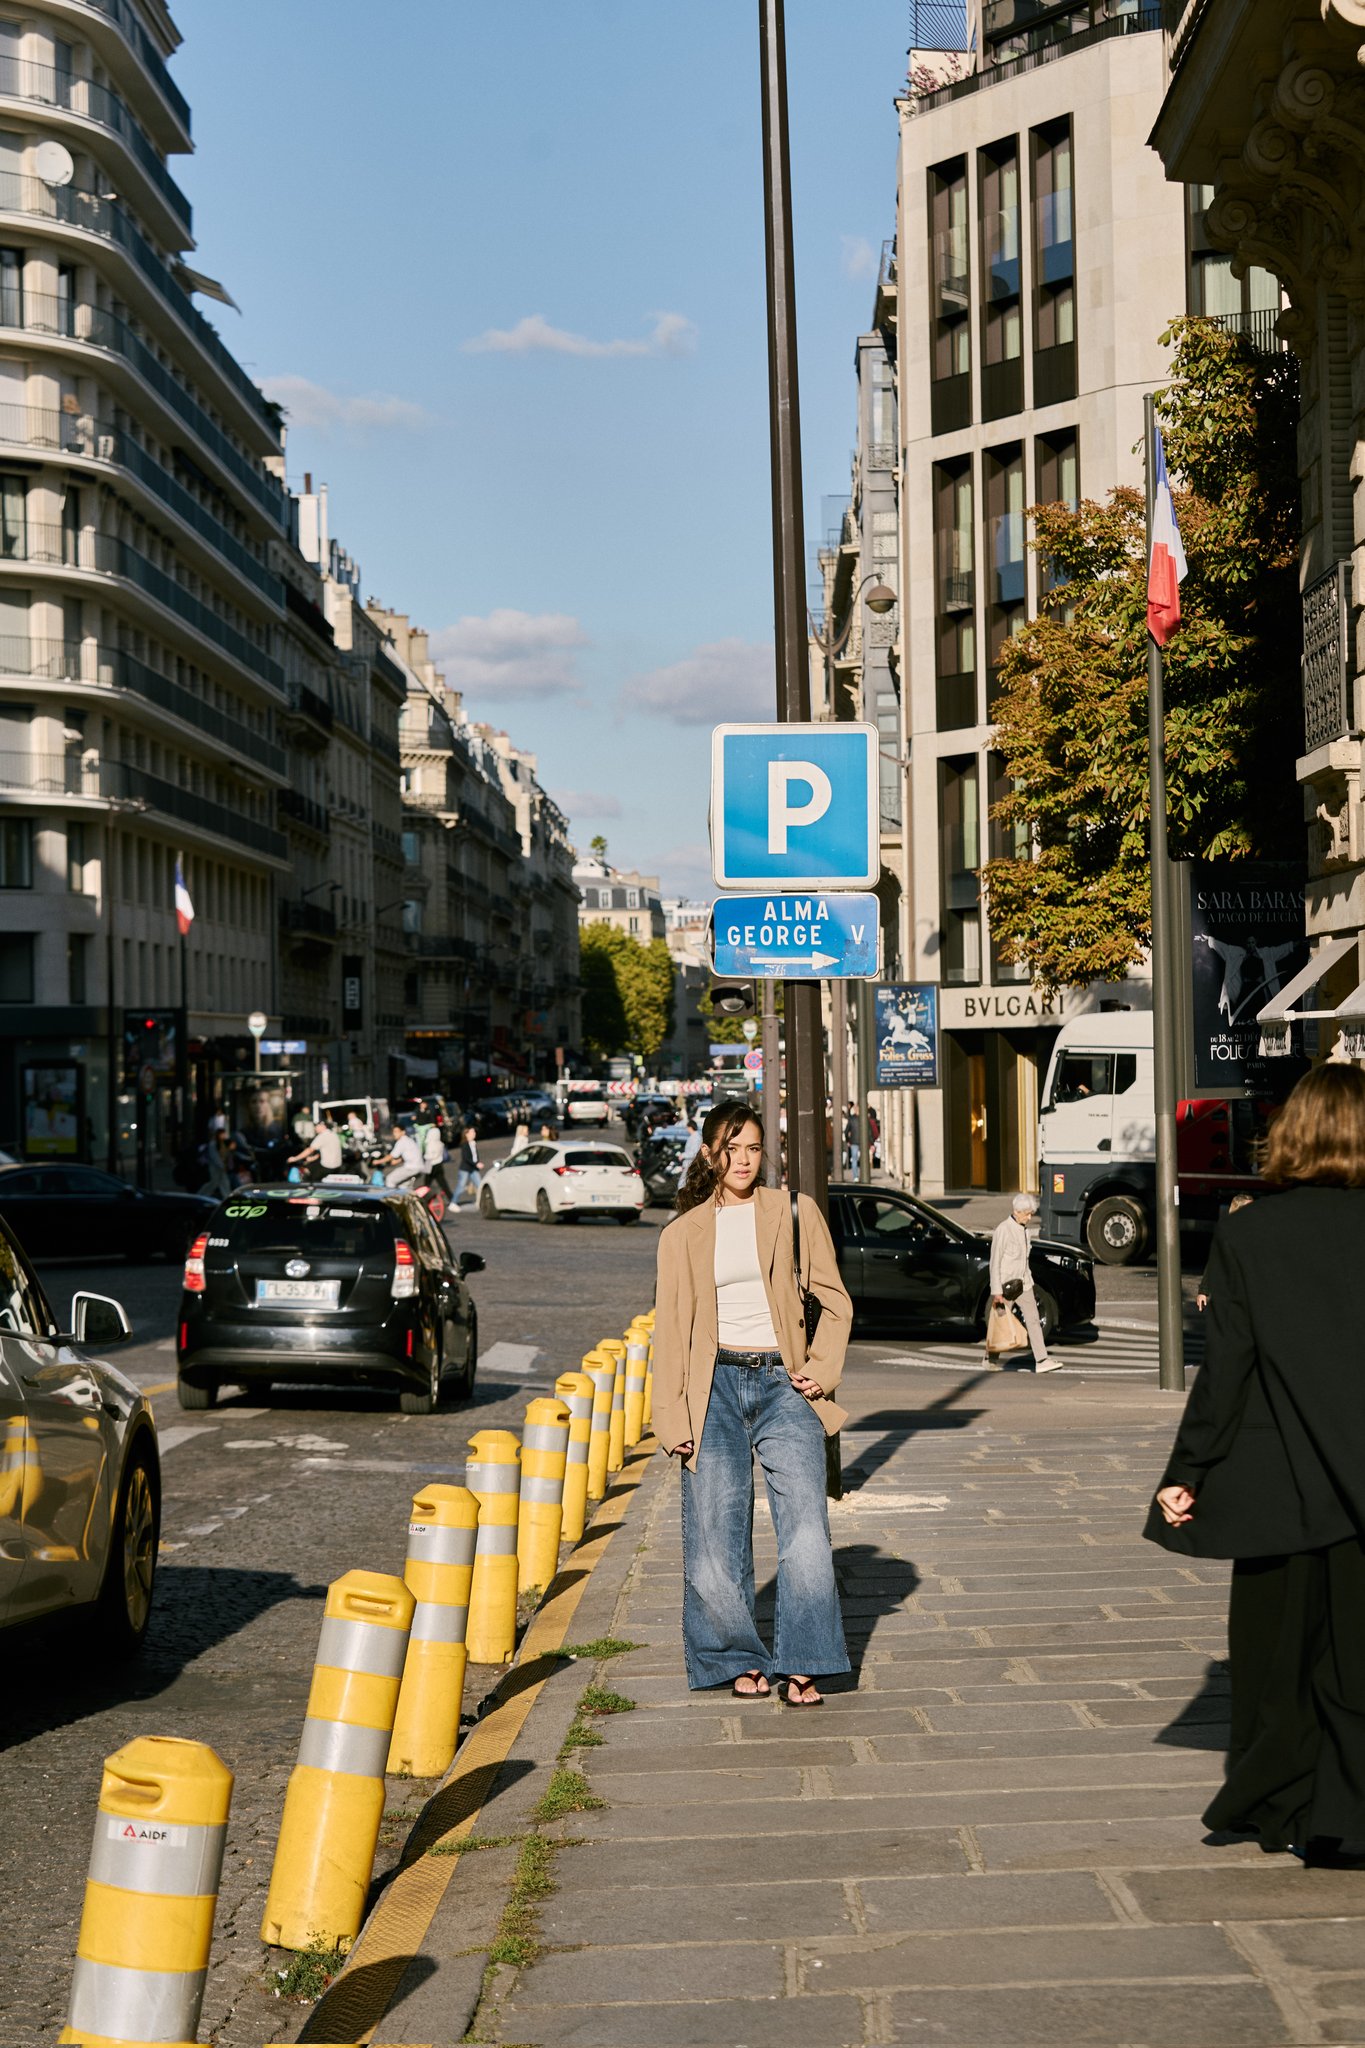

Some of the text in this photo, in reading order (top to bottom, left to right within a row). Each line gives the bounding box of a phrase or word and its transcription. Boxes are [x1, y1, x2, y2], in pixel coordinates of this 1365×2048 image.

[768, 761, 832, 854] P
[1197, 890, 1305, 910] SARA BARAS
[763, 901, 829, 921] ALMA
[1207, 913, 1216, 923] A
[1217, 913, 1246, 923] PACO
[1250, 912, 1264, 923] DE
[727, 924, 865, 945] GEORGE V
[965, 995, 1064, 1017] BVLGARI
[1218, 1033, 1227, 1043] 18
[1210, 1044, 1252, 1061] FOLIES
[140, 1830, 168, 1840] AIDF
